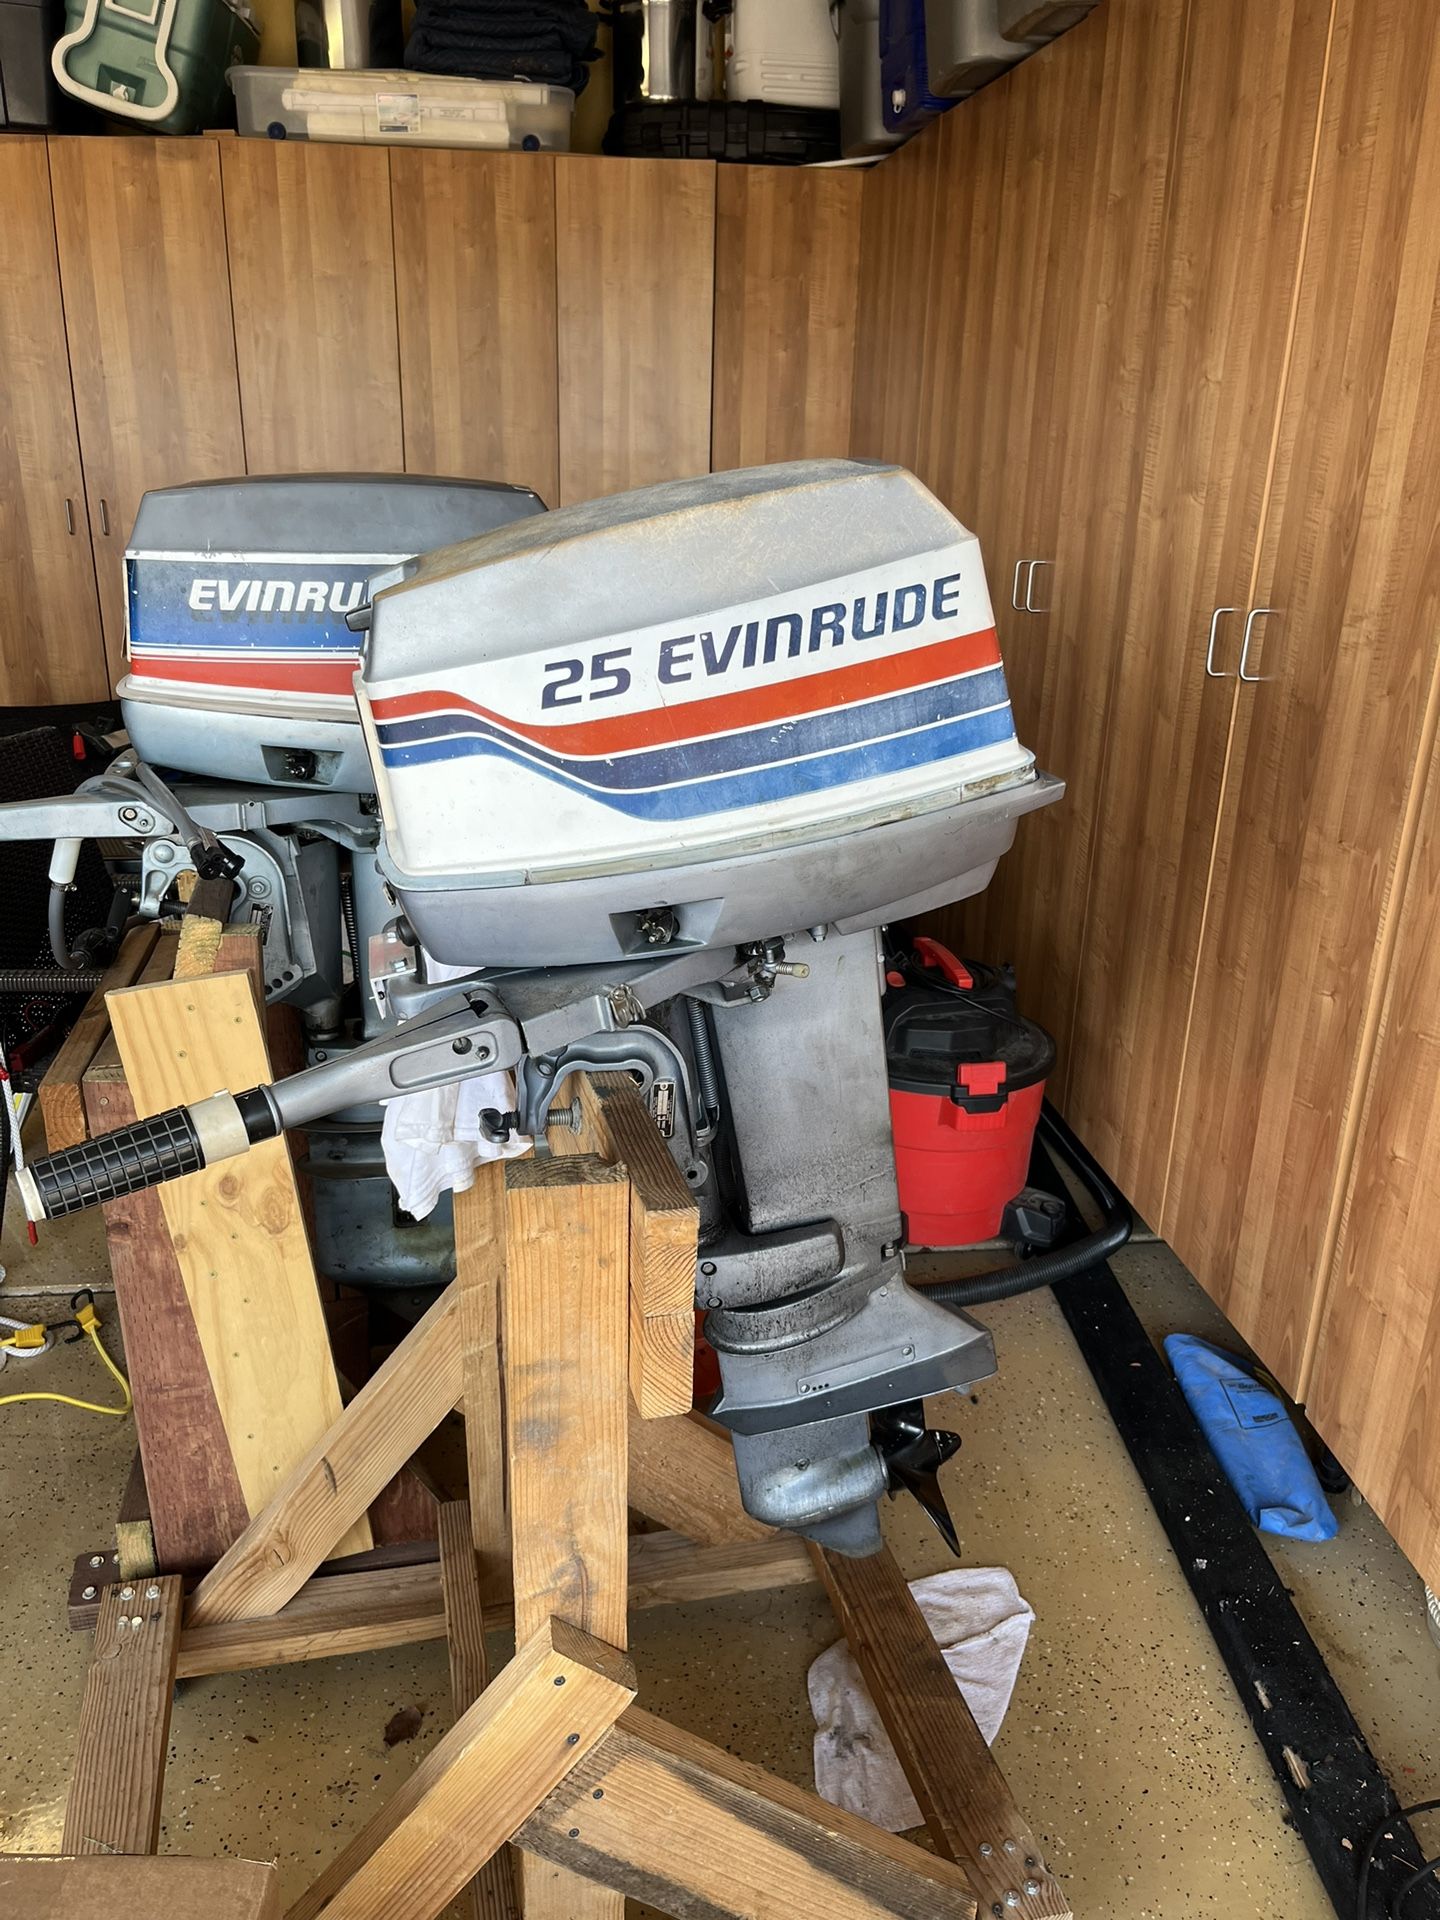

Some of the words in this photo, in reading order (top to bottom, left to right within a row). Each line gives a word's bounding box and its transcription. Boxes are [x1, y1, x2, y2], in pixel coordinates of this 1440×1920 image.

[188, 579, 367, 612] EVINRU
[541, 647, 632, 710] 25
[657, 572, 961, 685] EVINRUDE
